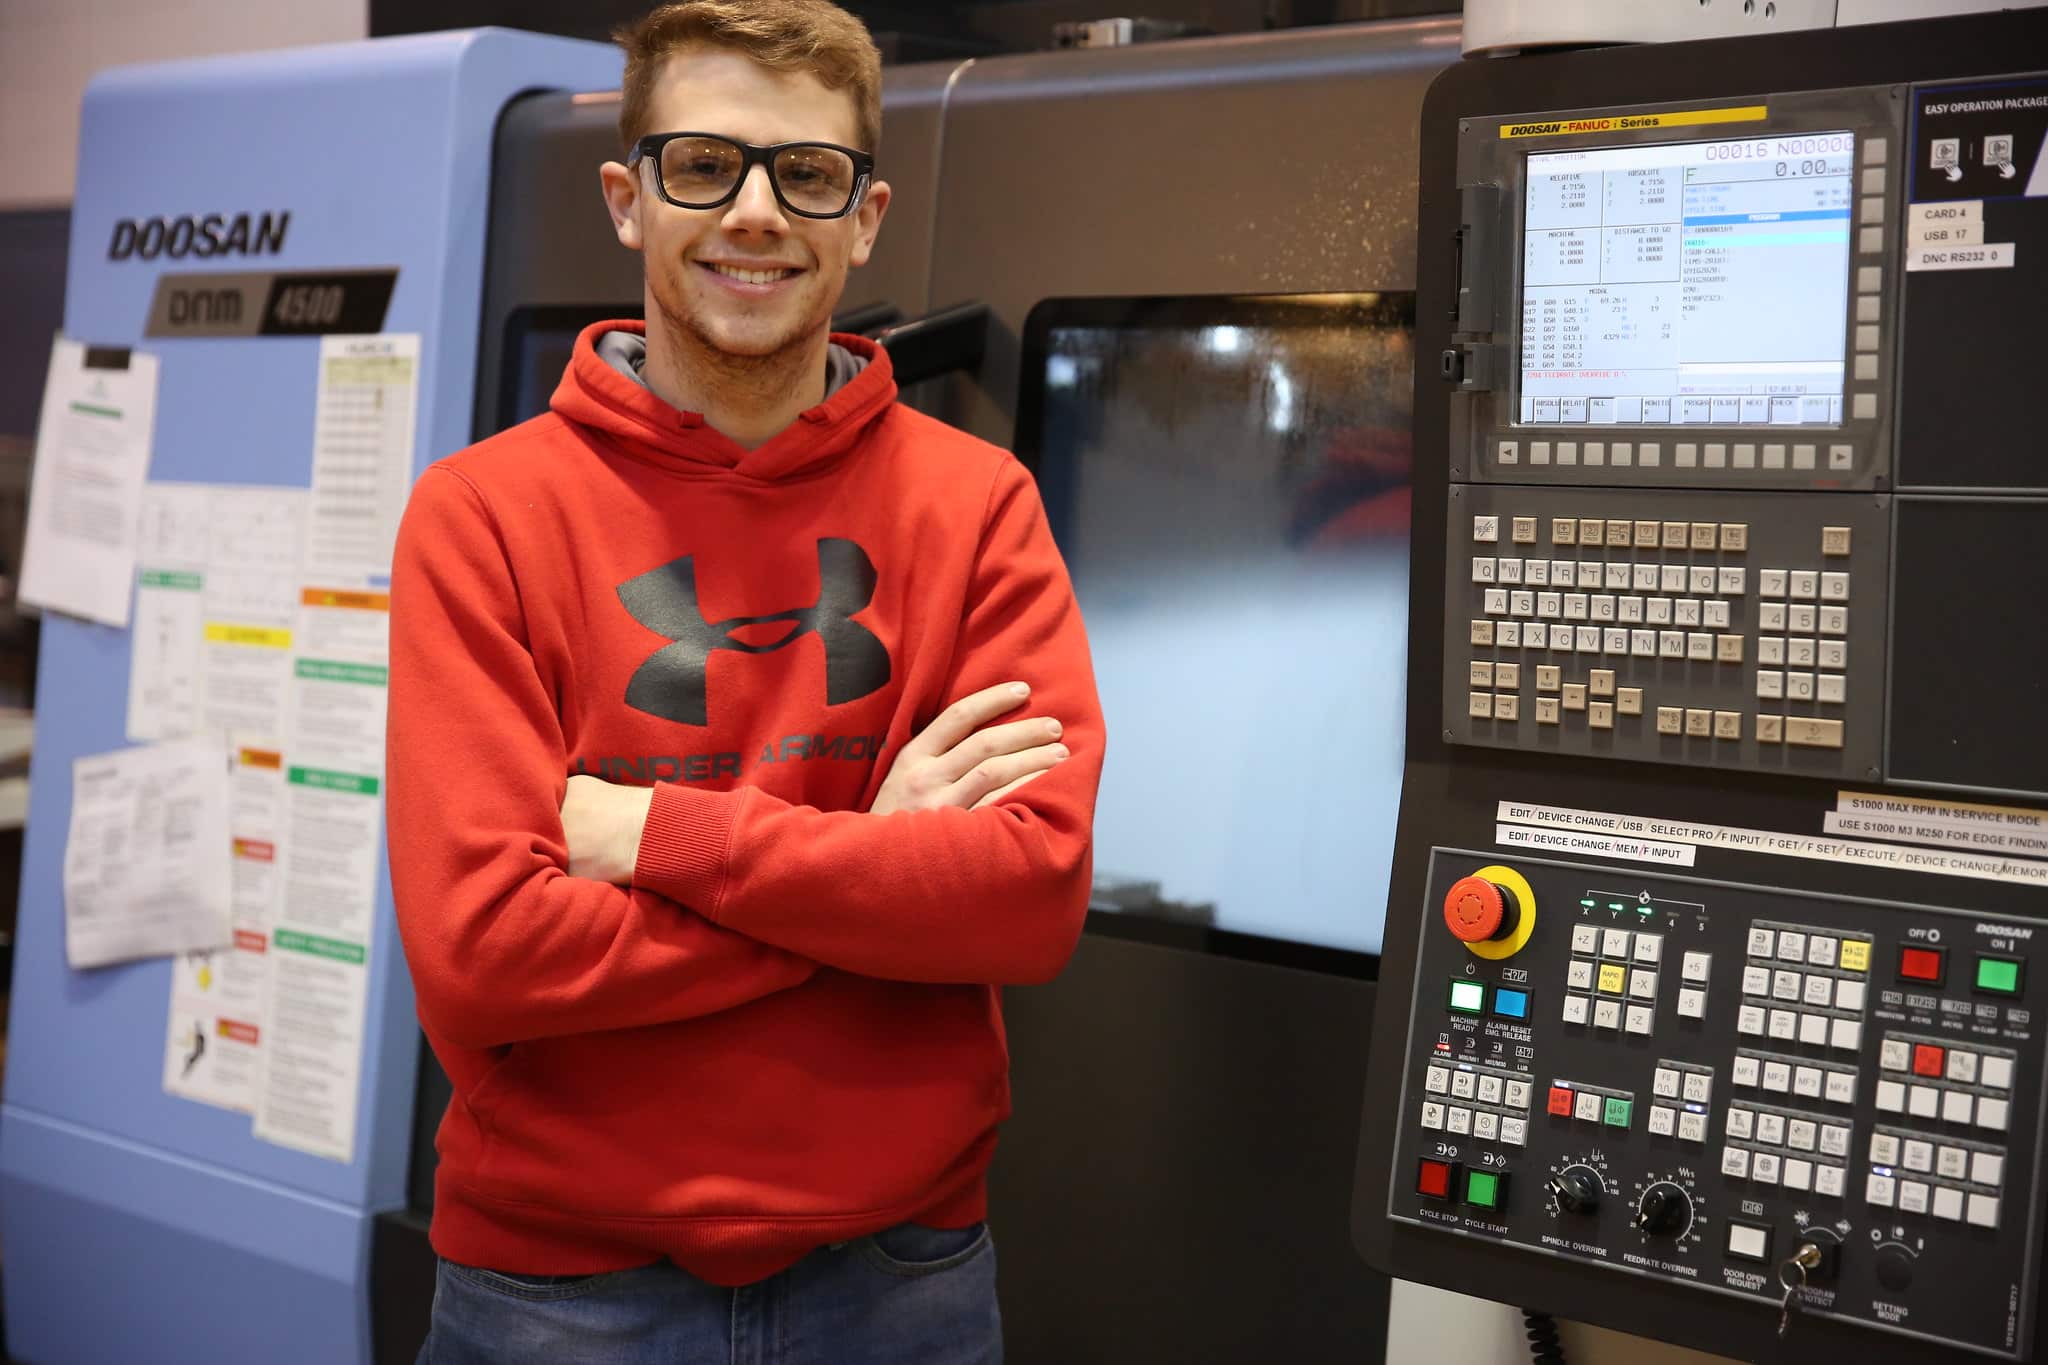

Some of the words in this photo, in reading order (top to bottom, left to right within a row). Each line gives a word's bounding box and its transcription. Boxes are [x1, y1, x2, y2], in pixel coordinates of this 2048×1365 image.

[1925, 103, 1949, 114] EASY
[1950, 99, 2003, 113] OPERATION
[2005, 95, 2048, 109] PACKAGE
[1620, 116, 1660, 129] Series
[1775, 160, 1827, 177] 0.00
[1925, 208, 1957, 219] CARD
[1959, 207, 1966, 217] 4
[108, 212, 291, 261] DOOSAN
[1924, 231, 1948, 241] USB
[1955, 229, 1967, 239] 17
[1922, 253, 1947, 264] DNC
[1950, 251, 1985, 262] RS232
[274, 284, 344, 325] 4500
[1482, 565, 1491, 577] Q
[1508, 566, 1518, 578] W
[1535, 568, 1544, 580] E
[1562, 569, 1570, 580] R
[1588, 570, 1598, 582] T
[1616, 571, 1626, 583] Y
[1645, 573, 1654, 585] U
[1701, 575, 1711, 588] O
[1730, 576, 1740, 588] P
[1771, 579, 1781, 591] 7
[1801, 580, 1812, 593] 8
[1833, 581, 1843, 594] 9
[1494, 598, 1503, 609] A
[1520, 599, 1529, 610] S
[1548, 601, 1556, 612] D
[1574, 602, 1583, 613] F
[1601, 604, 1611, 615] G
[1629, 606, 1638, 617] H
[1658, 608, 1666, 619] J
[1686, 609, 1695, 620] K
[1715, 611, 1724, 622] L
[1771, 613, 1780, 624] 4
[1801, 614, 1811, 627] 5
[1831, 616, 1841, 629] 6
[1506, 630, 1515, 641] Z
[1534, 631, 1542, 642] X
[1560, 634, 1569, 645] C
[1586, 635, 1596, 646] V
[1615, 637, 1623, 649] B
[1642, 640, 1651, 651] N
[1670, 641, 1680, 652] M
[1771, 648, 1777, 659] 1
[1800, 648, 1810, 661] 2
[1831, 650, 1840, 663] 3
[577, 752, 742, 781] UNDER
[755, 733, 887, 768] ARMOU
[1852, 799, 1884, 811] S1000
[1886, 802, 1910, 813] MAX
[1912, 805, 1936, 816] RPM
[1939, 807, 1951, 818] IN
[1953, 809, 2003, 823] SERVICE
[2006, 814, 2041, 826] MODE
[1537, 811, 1573, 823] DEVICE
[1650, 824, 1689, 837] SELECT
[1692, 829, 1713, 840] PRO
[1730, 833, 1761, 846] INPUT
[1846, 847, 1897, 862] EXECUTE
[1906, 854, 1947, 868] DEVICE
[1839, 819, 1860, 830] USE
[1863, 821, 1895, 834] S1000
[1898, 825, 1913, 836] M3
[1916, 827, 1944, 839] M250
[1946, 830, 1970, 842] FOR
[1972, 832, 2005, 846] EDGE
[2008, 836, 2048, 849] FINDIN
[1533, 834, 1569, 847] DEVICE
[1652, 847, 1681, 859] INPUT
[1908, 928, 1927, 938] OFF
[1975, 923, 2032, 939] DOOSAN
[1990, 938, 2006, 949] ON
[1602, 970, 1619, 978] RAPID
[1450, 1015, 1480, 1027] MACHINE
[1452, 1022, 1476, 1033] READY
[1486, 1021, 1509, 1032] ALARM
[1510, 1024, 1532, 1035] RESET
[1502, 1030, 1532, 1042] RELEASE
[1433, 1050, 1452, 1058] ALARM
[1419, 1208, 1440, 1219] CYCLE
[1442, 1213, 1459, 1223] STOP
[1464, 1218, 1486, 1230] CYCLE
[1487, 1223, 1509, 1235] START
[1541, 1235, 1570, 1248] SPINDLE
[1572, 1242, 1607, 1257] OVERRIDE
[1623, 1253, 1660, 1269] FEEDRATE
[1661, 1261, 1698, 1277] OVERRIDE
[1723, 1268, 1745, 1280] DOOR
[1746, 1272, 1767, 1285] OPEN
[1726, 1277, 1762, 1291] REQUEST
[1872, 1301, 1909, 1316] SETTING
[1877, 1311, 1900, 1322] MODE
